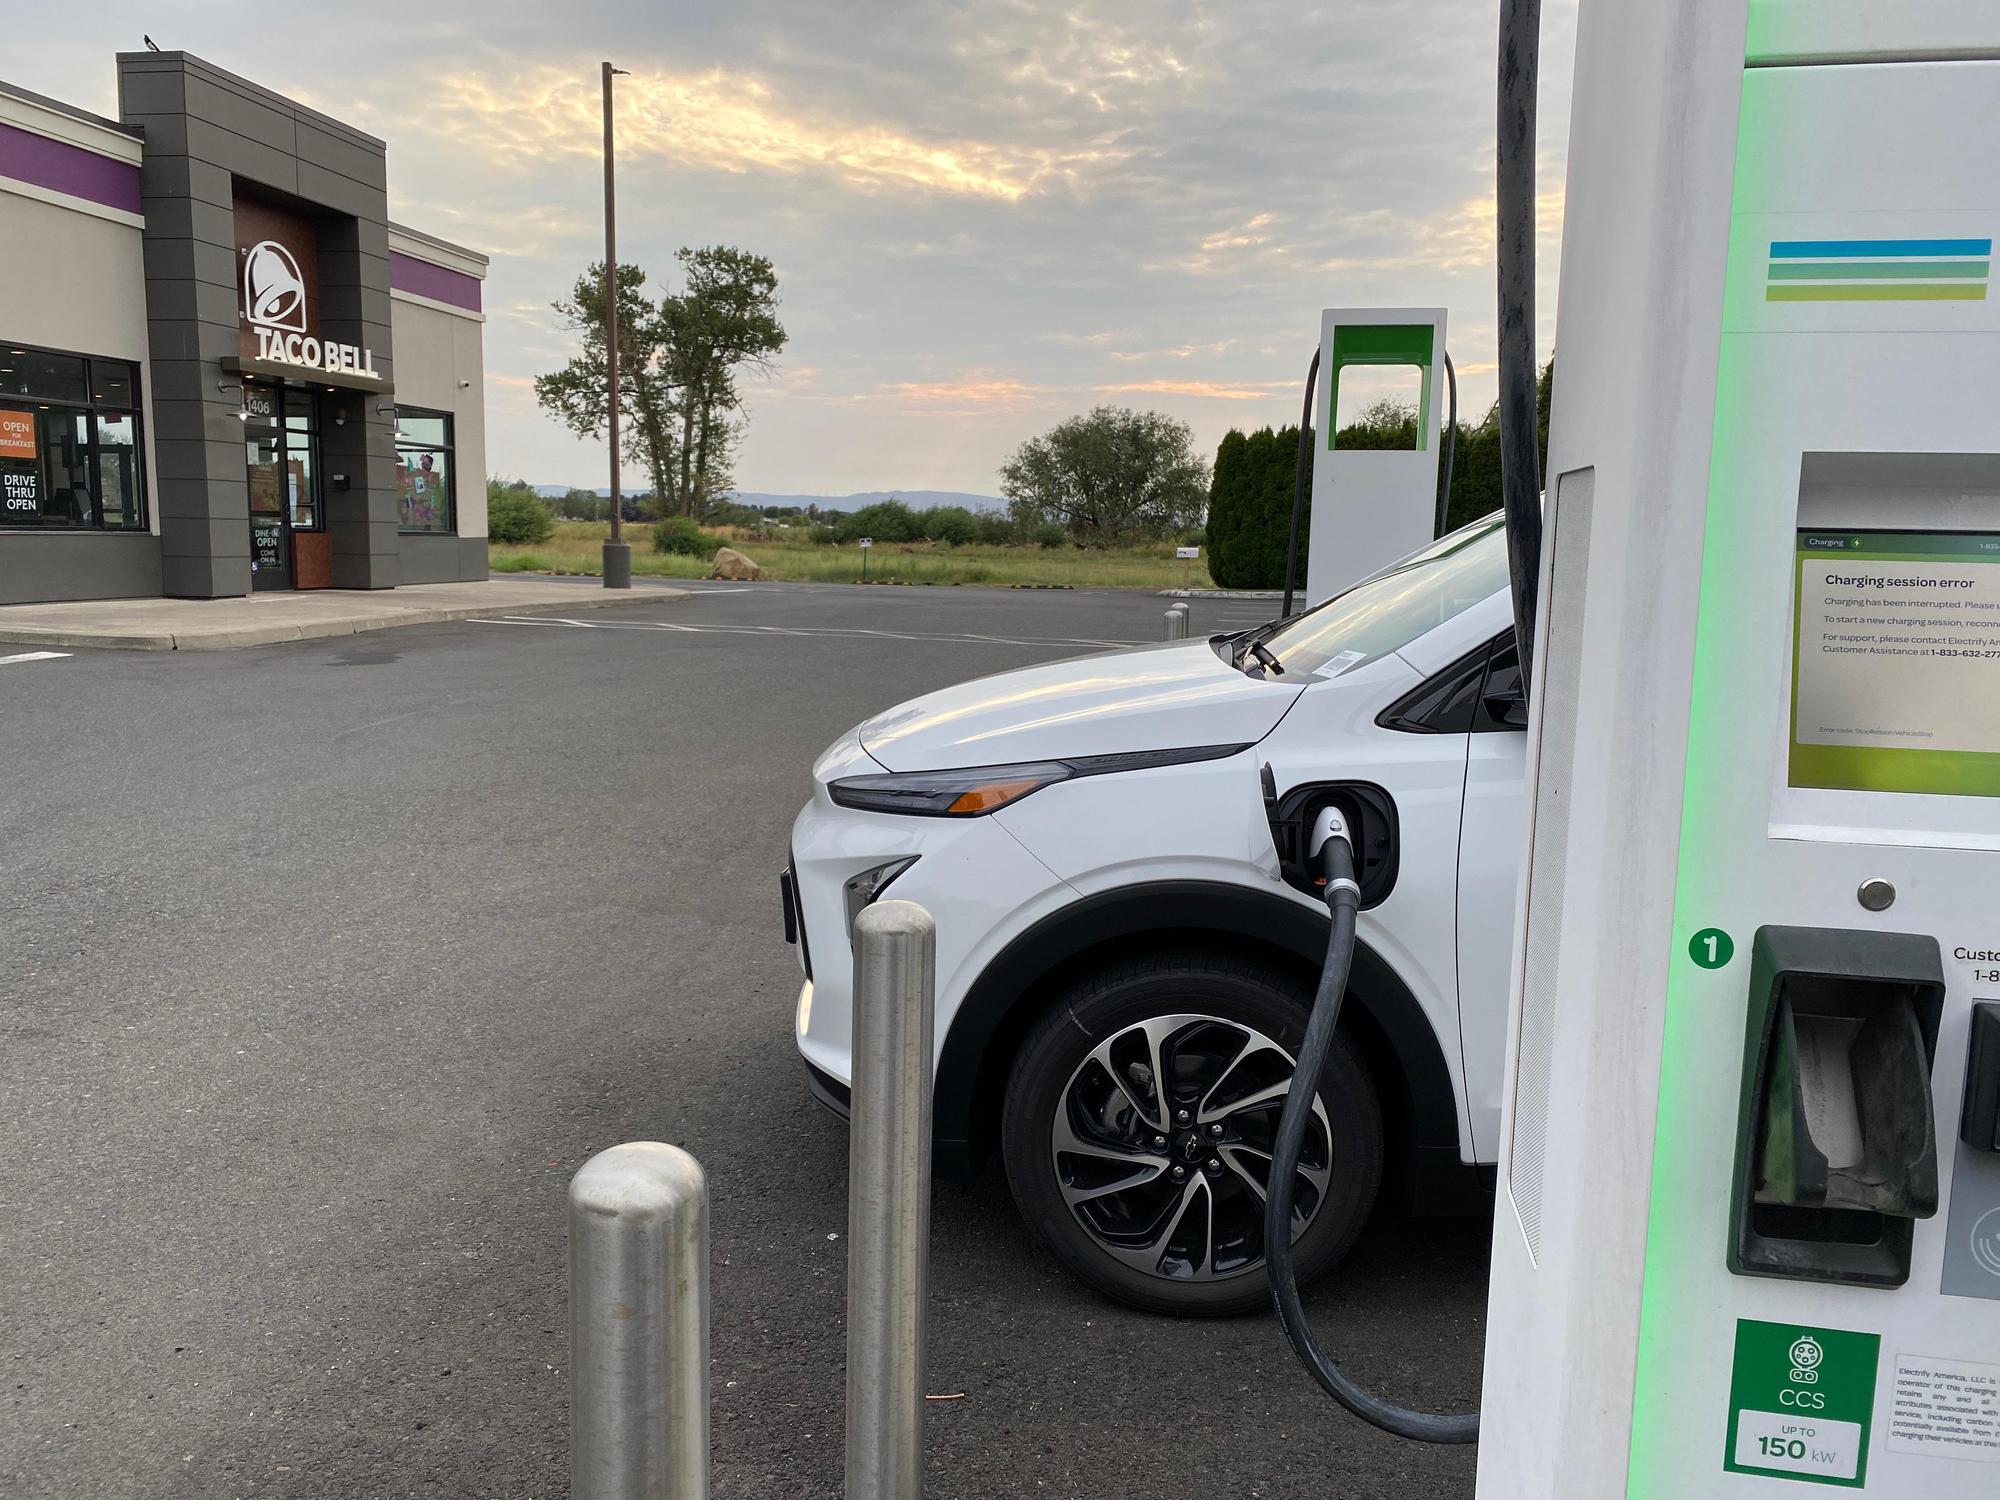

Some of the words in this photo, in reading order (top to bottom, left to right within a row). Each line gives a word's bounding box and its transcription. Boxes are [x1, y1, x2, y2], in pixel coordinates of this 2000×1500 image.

[254, 326, 321, 368] TACO
[324, 341, 379, 378] BELL
[246, 399, 270, 414] 1406
[3, 421, 29, 432] OPEN
[0, 439, 34, 448] BREAKFAST
[4, 474, 36, 486] DRIVE
[6, 487, 35, 498] THRU
[6, 499, 36, 510] OPEN
[255, 529, 279, 538] DINE-IN
[257, 537, 277, 547] OPEN
[1809, 538, 1844, 547] Charging
[1825, 575, 1884, 588] Charging
[1887, 576, 1936, 587] session
[1940, 579, 1975, 588] error
[1824, 598, 1864, 607] Charging
[1908, 600, 1962, 609] interrupted.
[1965, 601, 1995, 609] Please
[1886, 617, 1926, 627] charging
[1927, 619, 1964, 627] session,
[1839, 635, 1878, 643] support,
[1880, 635, 1909, 643] please
[1949, 637, 1987, 647] Electrify
[1869, 647, 1918, 655] Assistance
[1703, 935, 1717, 962] 1
[1974, 969, 2000, 982] 1-8
[1899, 1368, 1930, 1377] Electrify
[1933, 1372, 1967, 1382] America,
[1897, 1379, 1930, 1388] operator
[1964, 1387, 1997, 1397] charging
[1779, 1389, 1825, 1409] CCS
[1896, 1390, 1922, 1398] retains
[1932, 1393, 1947, 1401] any
[1895, 1400, 1932, 1409] attributes
[1936, 1405, 1978, 1414] associated
[1927, 1413, 1962, 1424] including
[1966, 1418, 1993, 1426] carbon
[1782, 1425, 1797, 1435] UP
[1800, 1427, 1816, 1437] TO
[1893, 1420, 1933, 1431] potentially
[1936, 1425, 1969, 1434] available
[1891, 1430, 1923, 1441] charging
[1943, 1437, 1973, 1445] vehicles
[1983, 1440, 1998, 1448] this
[1759, 1436, 1806, 1459] 150
[1811, 1449, 1836, 1463] kW
